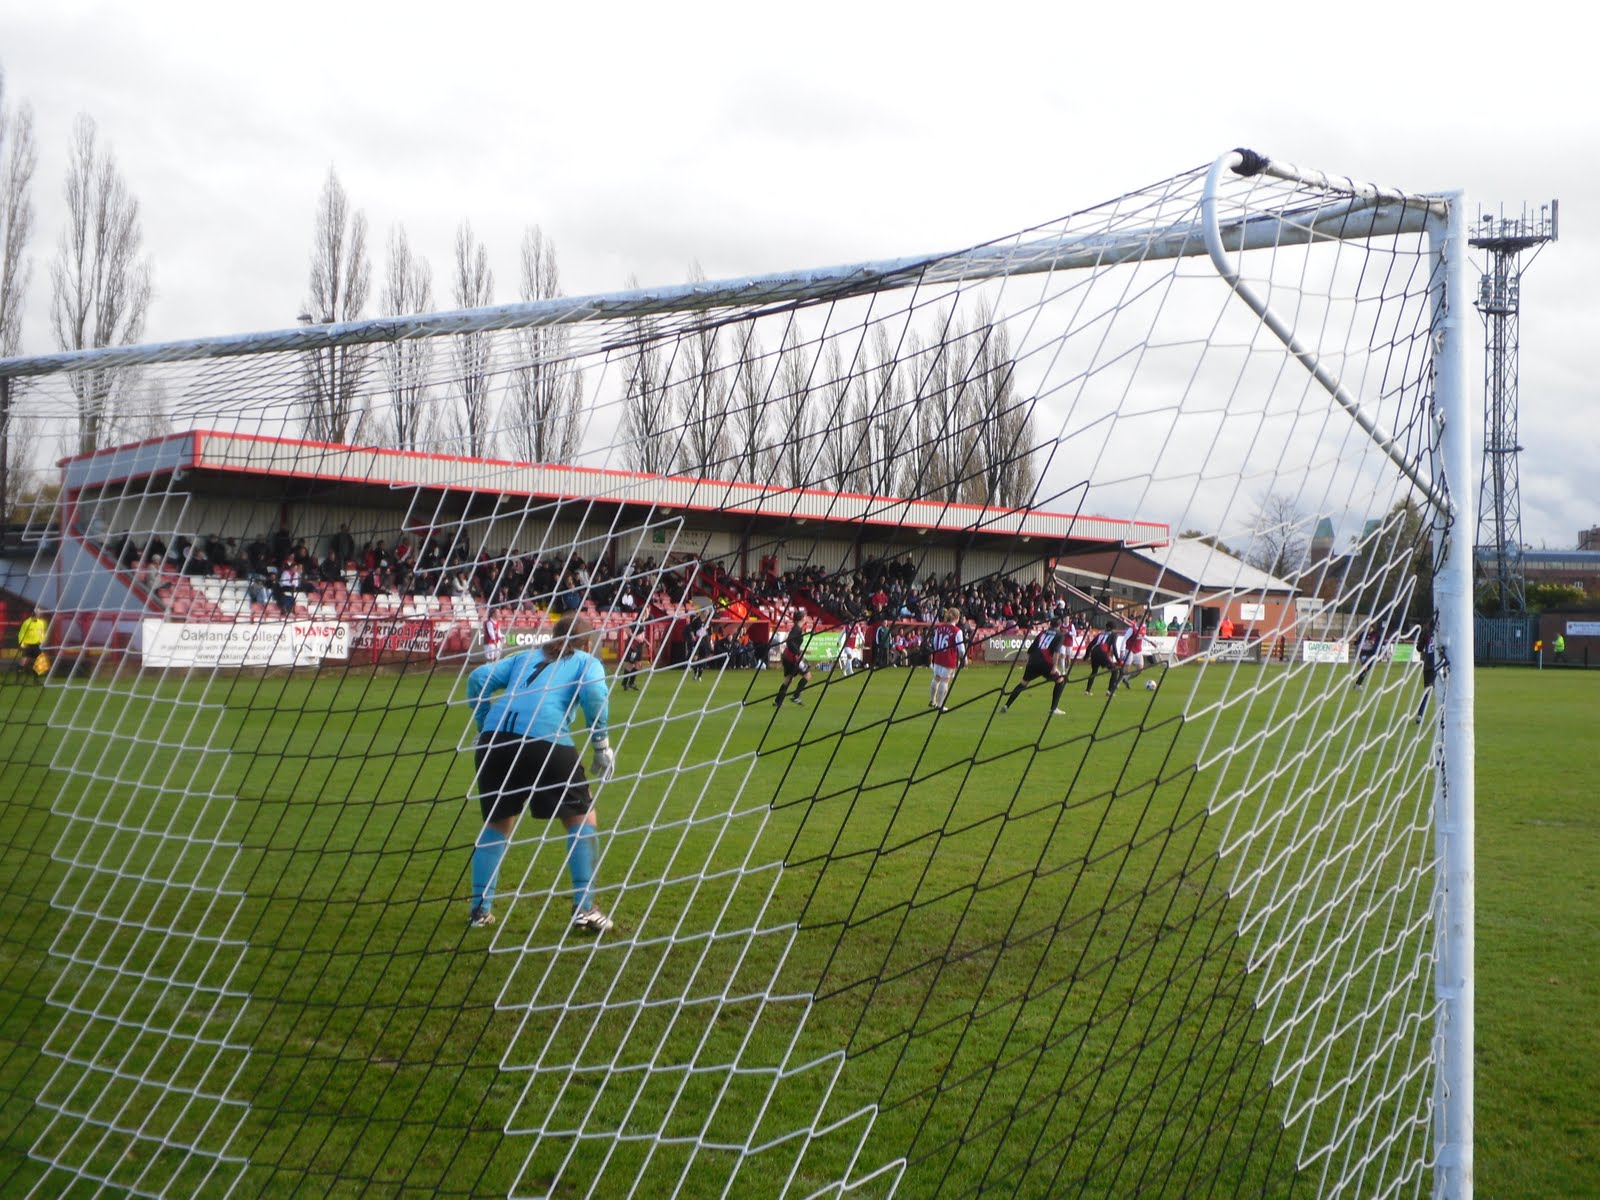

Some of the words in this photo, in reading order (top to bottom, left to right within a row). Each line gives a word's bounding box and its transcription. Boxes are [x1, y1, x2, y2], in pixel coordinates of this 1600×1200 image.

[180, 629, 238, 641] Oaklands
[242, 630, 286, 644] College
[938, 633, 950, 651] 16
